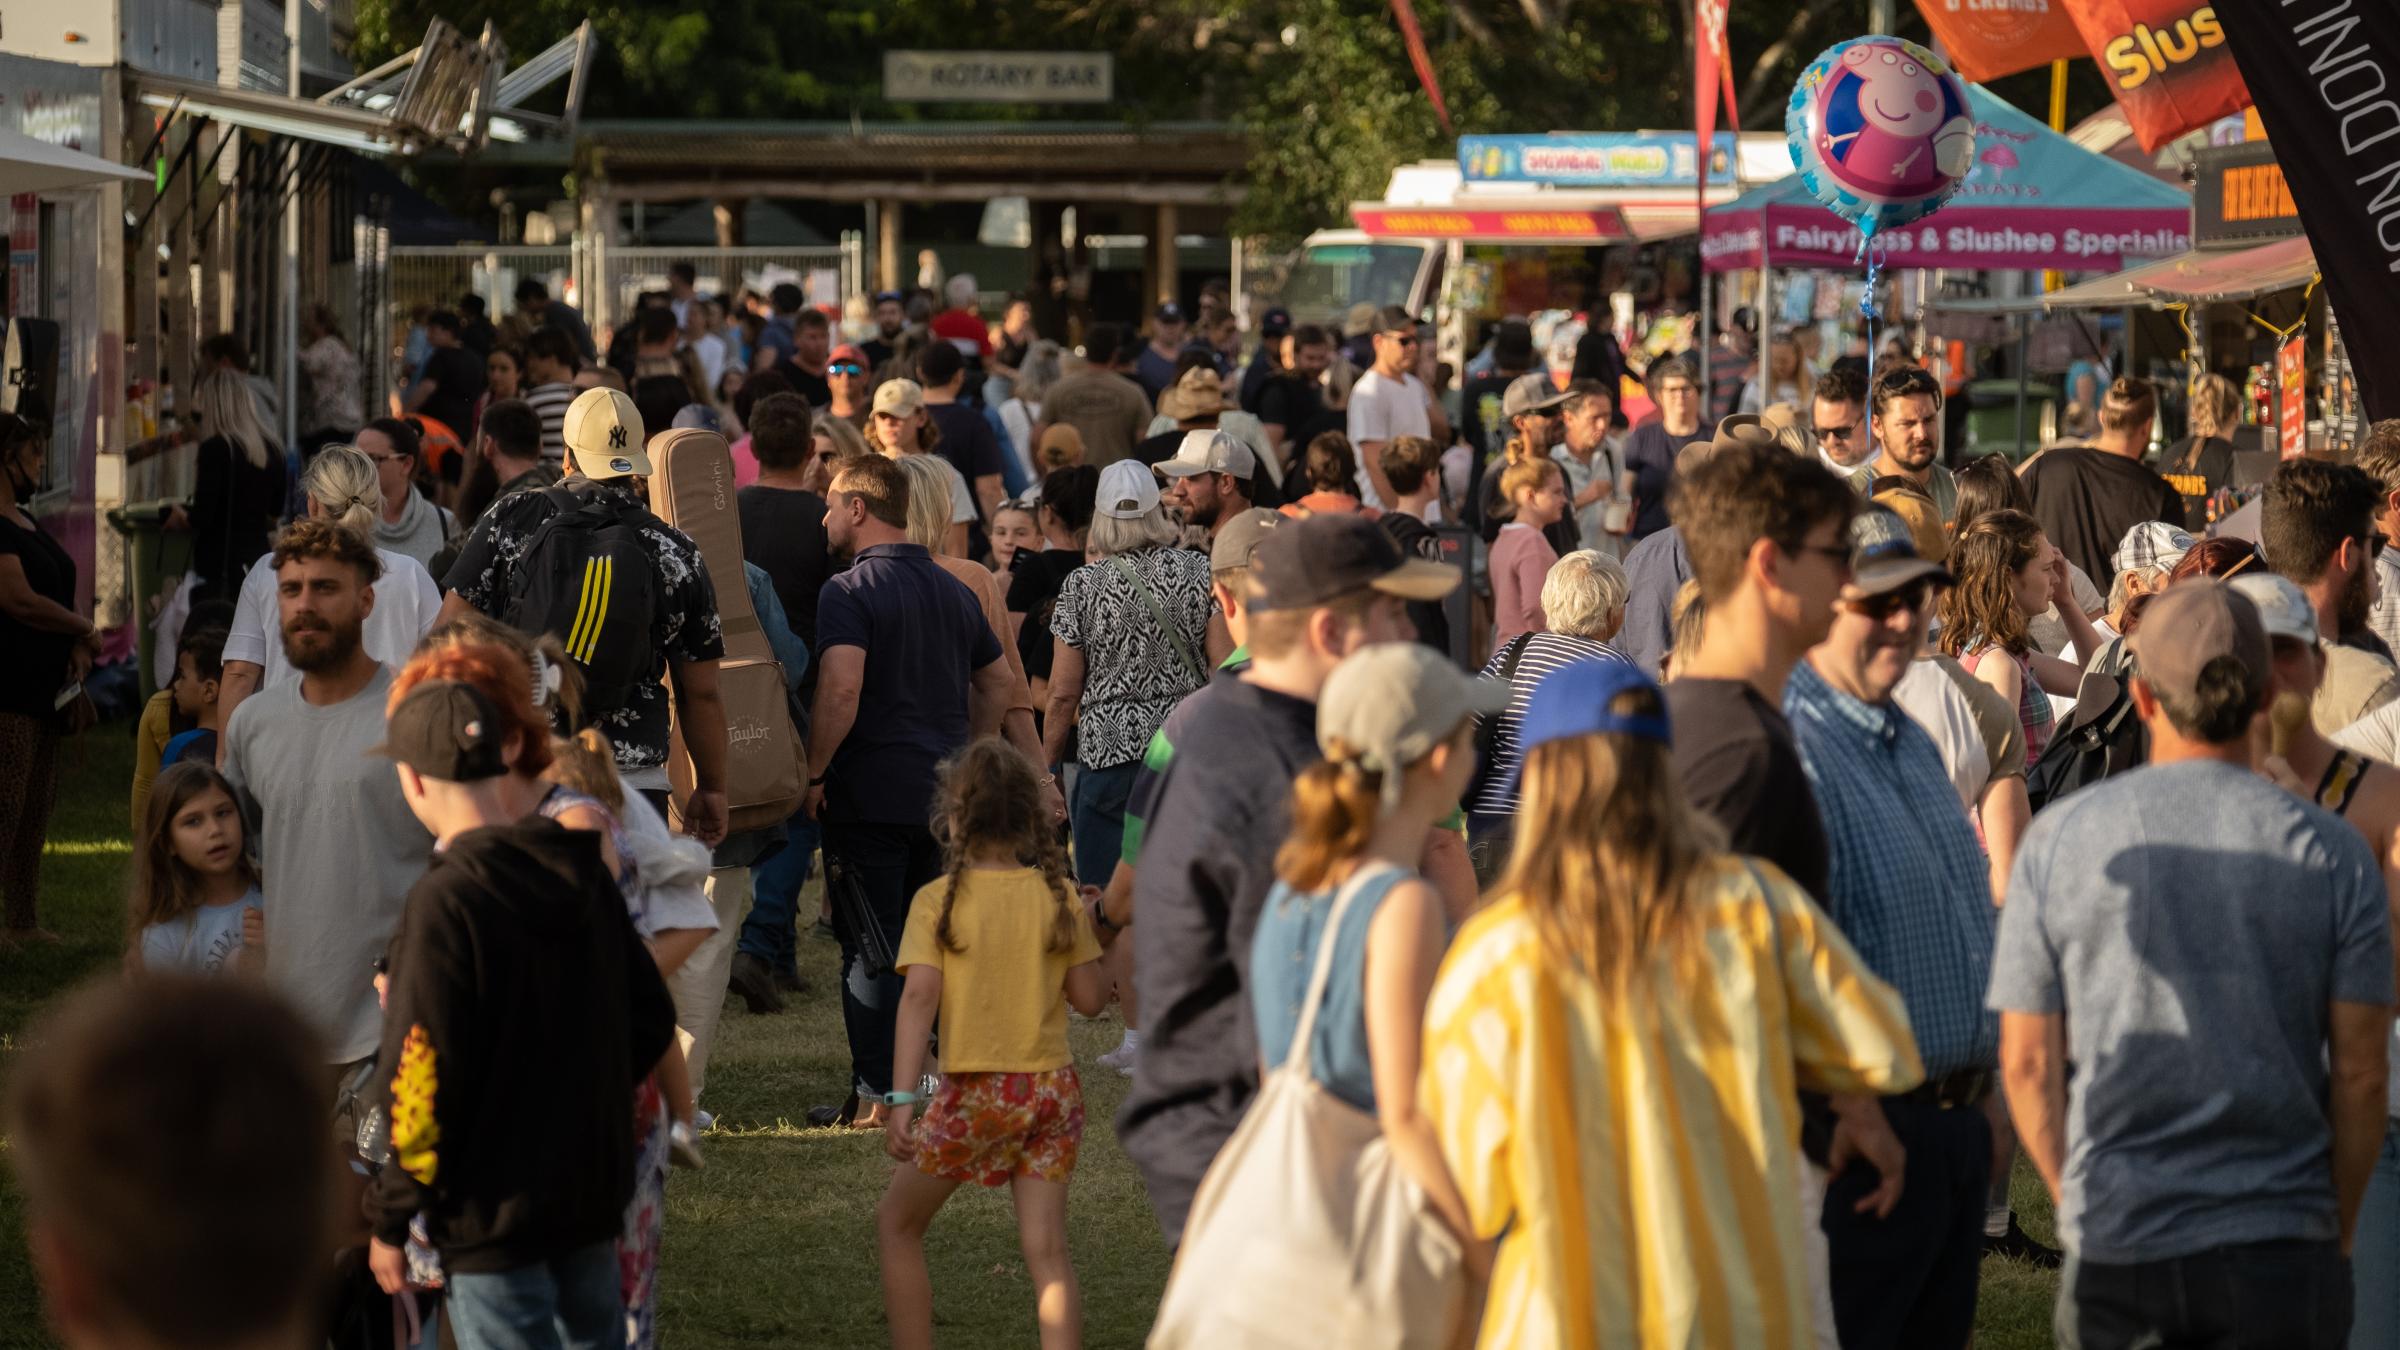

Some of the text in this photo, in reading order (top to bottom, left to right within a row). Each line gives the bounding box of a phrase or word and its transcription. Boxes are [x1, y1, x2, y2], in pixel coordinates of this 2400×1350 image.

[2105, 6, 2226, 90] Slus
[930, 63, 1100, 87] ROTARY BAR
[1776, 225, 1913, 254] Fairyfoss
[1920, 227, 1940, 252] &
[1947, 226, 2057, 252] Slushee
[727, 723, 770, 746] Taylor
